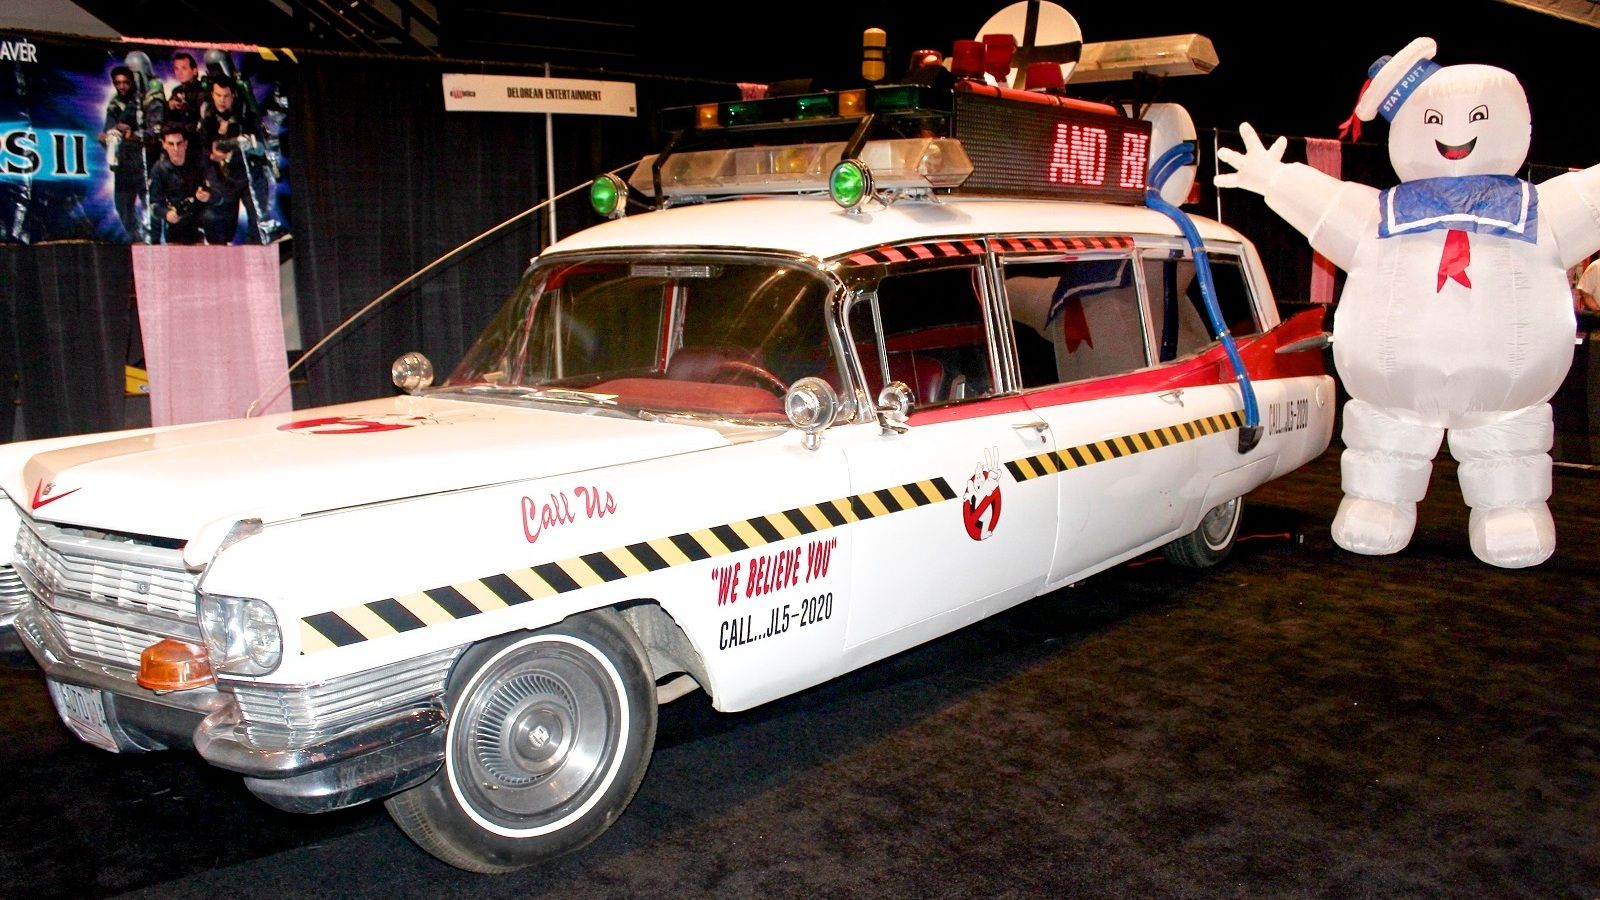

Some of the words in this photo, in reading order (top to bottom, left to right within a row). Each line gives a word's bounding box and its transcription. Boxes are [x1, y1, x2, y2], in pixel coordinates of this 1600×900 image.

[507, 87, 543, 99] DELOREAN
[545, 88, 602, 101] ENTERTAINMENT
[1383, 89, 1401, 112] STAY
[1401, 65, 1425, 89] PUFT
[49, 132, 90, 177] II
[1049, 123, 1107, 186] AND
[521, 492, 576, 543] Call
[574, 485, 617, 518] Us
[745, 546, 801, 599] BELIEVE
